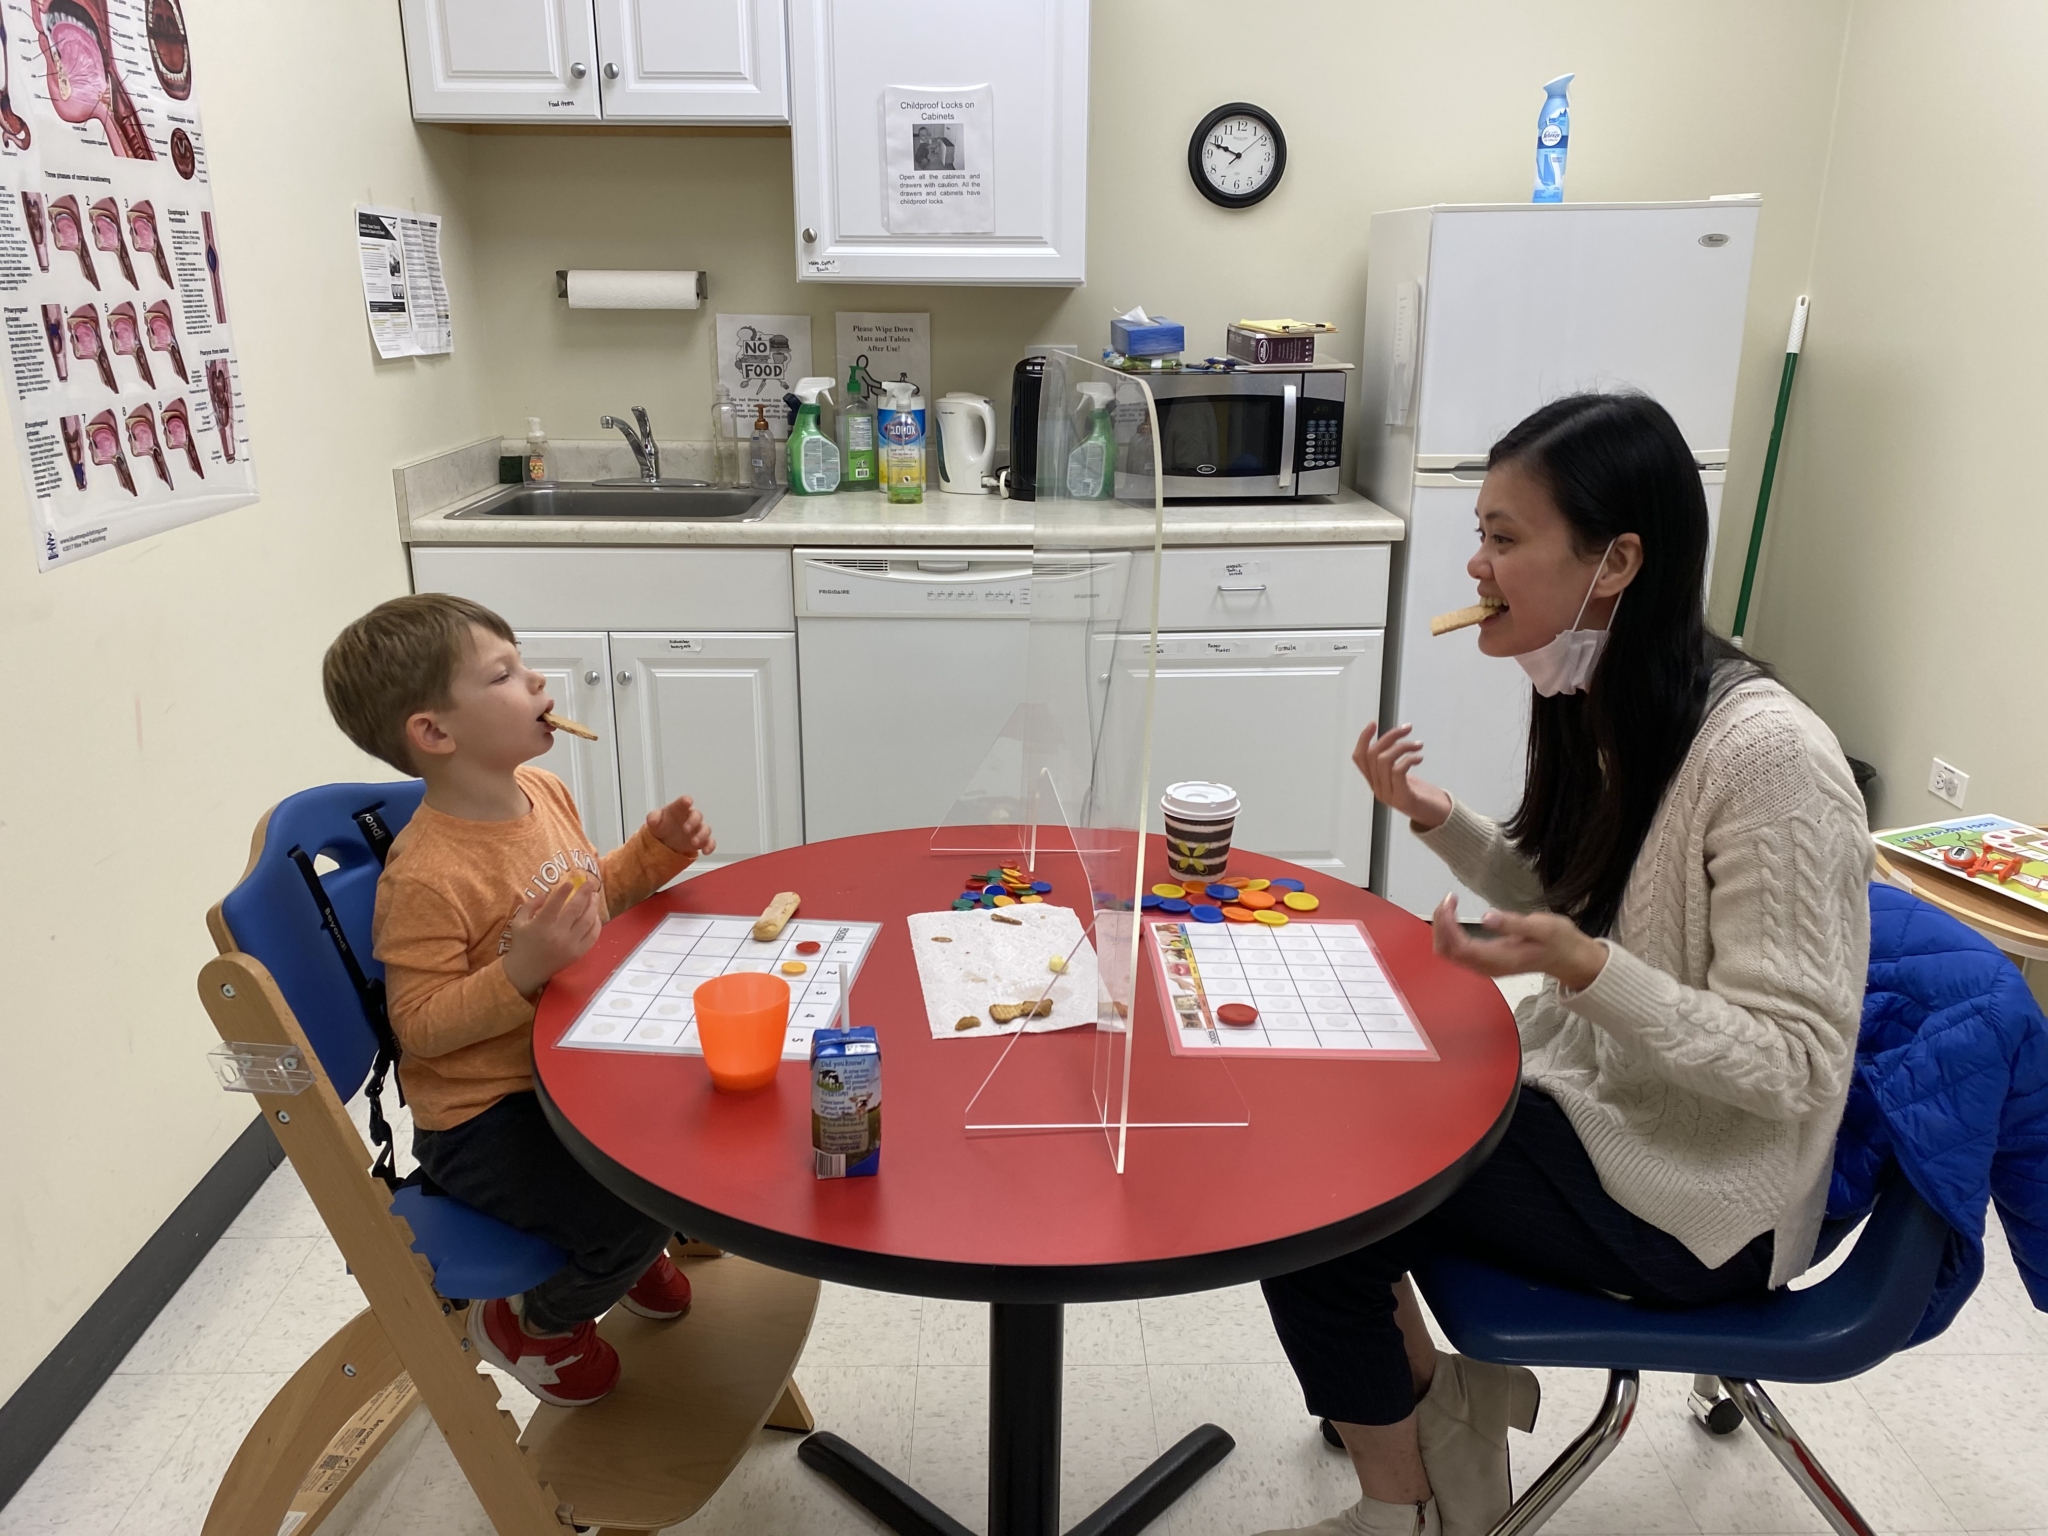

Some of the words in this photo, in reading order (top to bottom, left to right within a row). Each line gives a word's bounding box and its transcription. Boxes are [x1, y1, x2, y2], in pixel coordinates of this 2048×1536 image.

[900, 101, 939, 110] Childproof
[941, 101, 963, 109] Locks
[921, 112, 955, 120] Cabinets
[1224, 125, 1233, 135] 11
[1236, 121, 1248, 132] 12
[1253, 126, 1257, 136] 1
[1213, 134, 1223, 145] 10
[1261, 136, 1267, 146] 2
[1207, 149, 1213, 158] 9
[1264, 152, 1270, 162] 3
[1210, 164, 1216, 174] 8
[1257, 165, 1263, 175] 4
[44, 170, 56, 179] Three
[90, 176, 111, 184] swallowing
[1221, 175, 1226, 186] 7
[1246, 177, 1253, 186] 5
[1234, 179, 1240, 190] 6
[45, 193, 48, 204] 1
[85, 196, 90, 206] 2
[124, 198, 129, 208] 3
[64, 306, 68, 315] 4
[104, 303, 109, 313] 5
[142, 302, 147, 311] 6
[875, 326, 892, 334] Wipe
[745, 342, 767, 354] NO
[745, 364, 782, 378] FOOD
[158, 401, 162, 410] 9
[122, 407, 126, 416] 8
[82, 414, 86, 424] 7
[835, 927, 849, 941] FOODS
